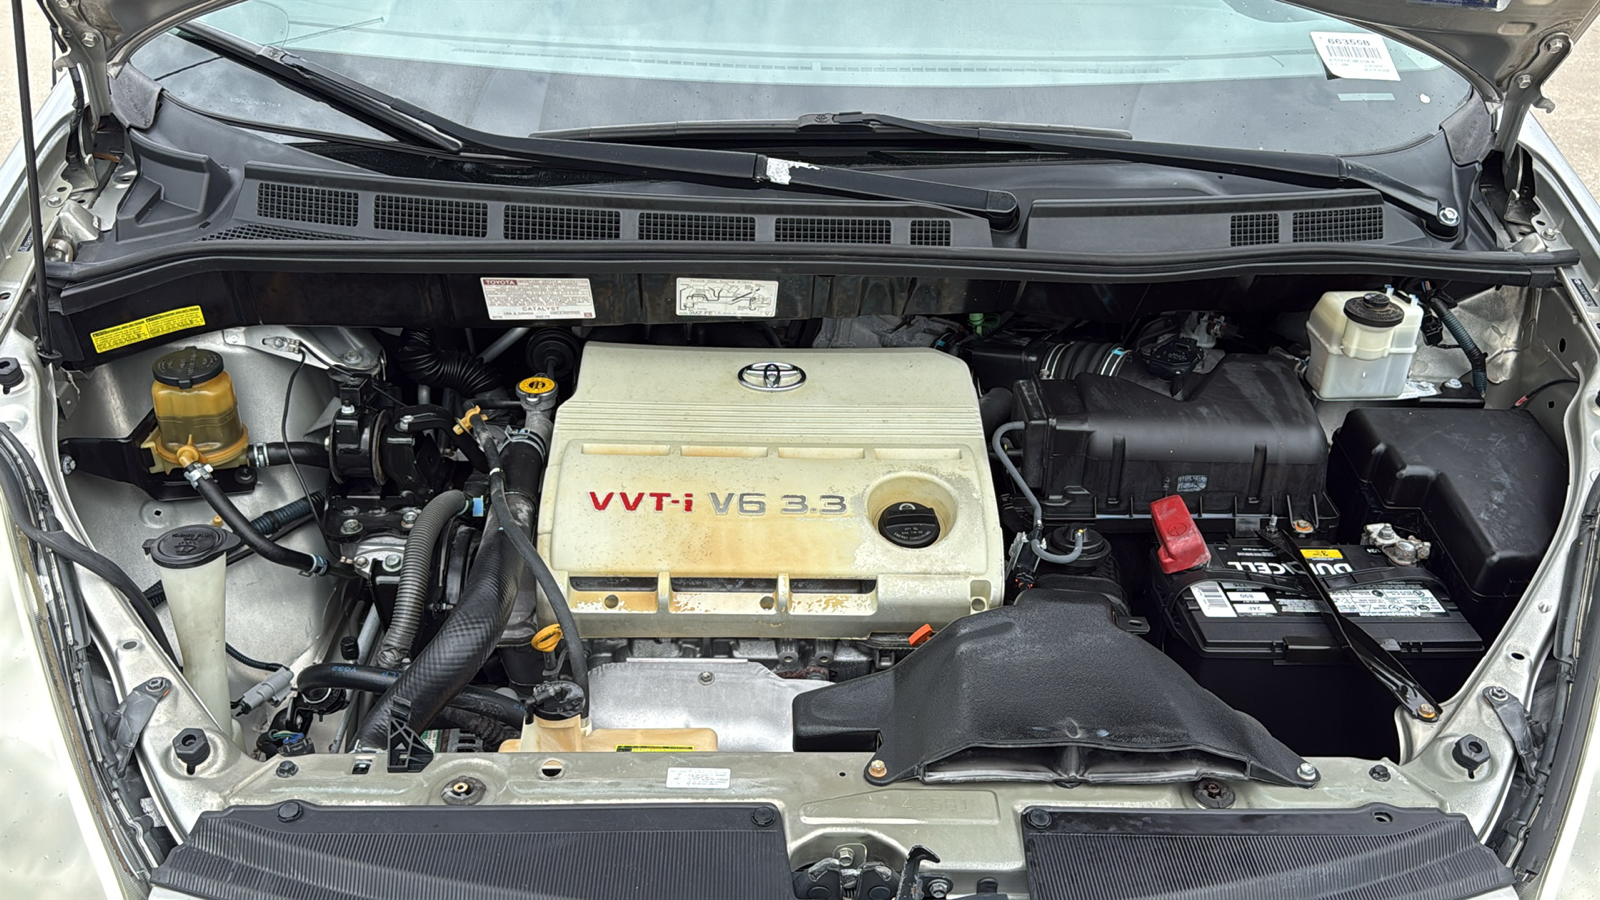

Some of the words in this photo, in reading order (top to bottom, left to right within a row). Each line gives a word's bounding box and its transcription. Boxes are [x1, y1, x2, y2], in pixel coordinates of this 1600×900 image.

[589, 491, 694, 512] VVT-i
[708, 492, 767, 516] V6
[781, 493, 847, 516] 3.3
